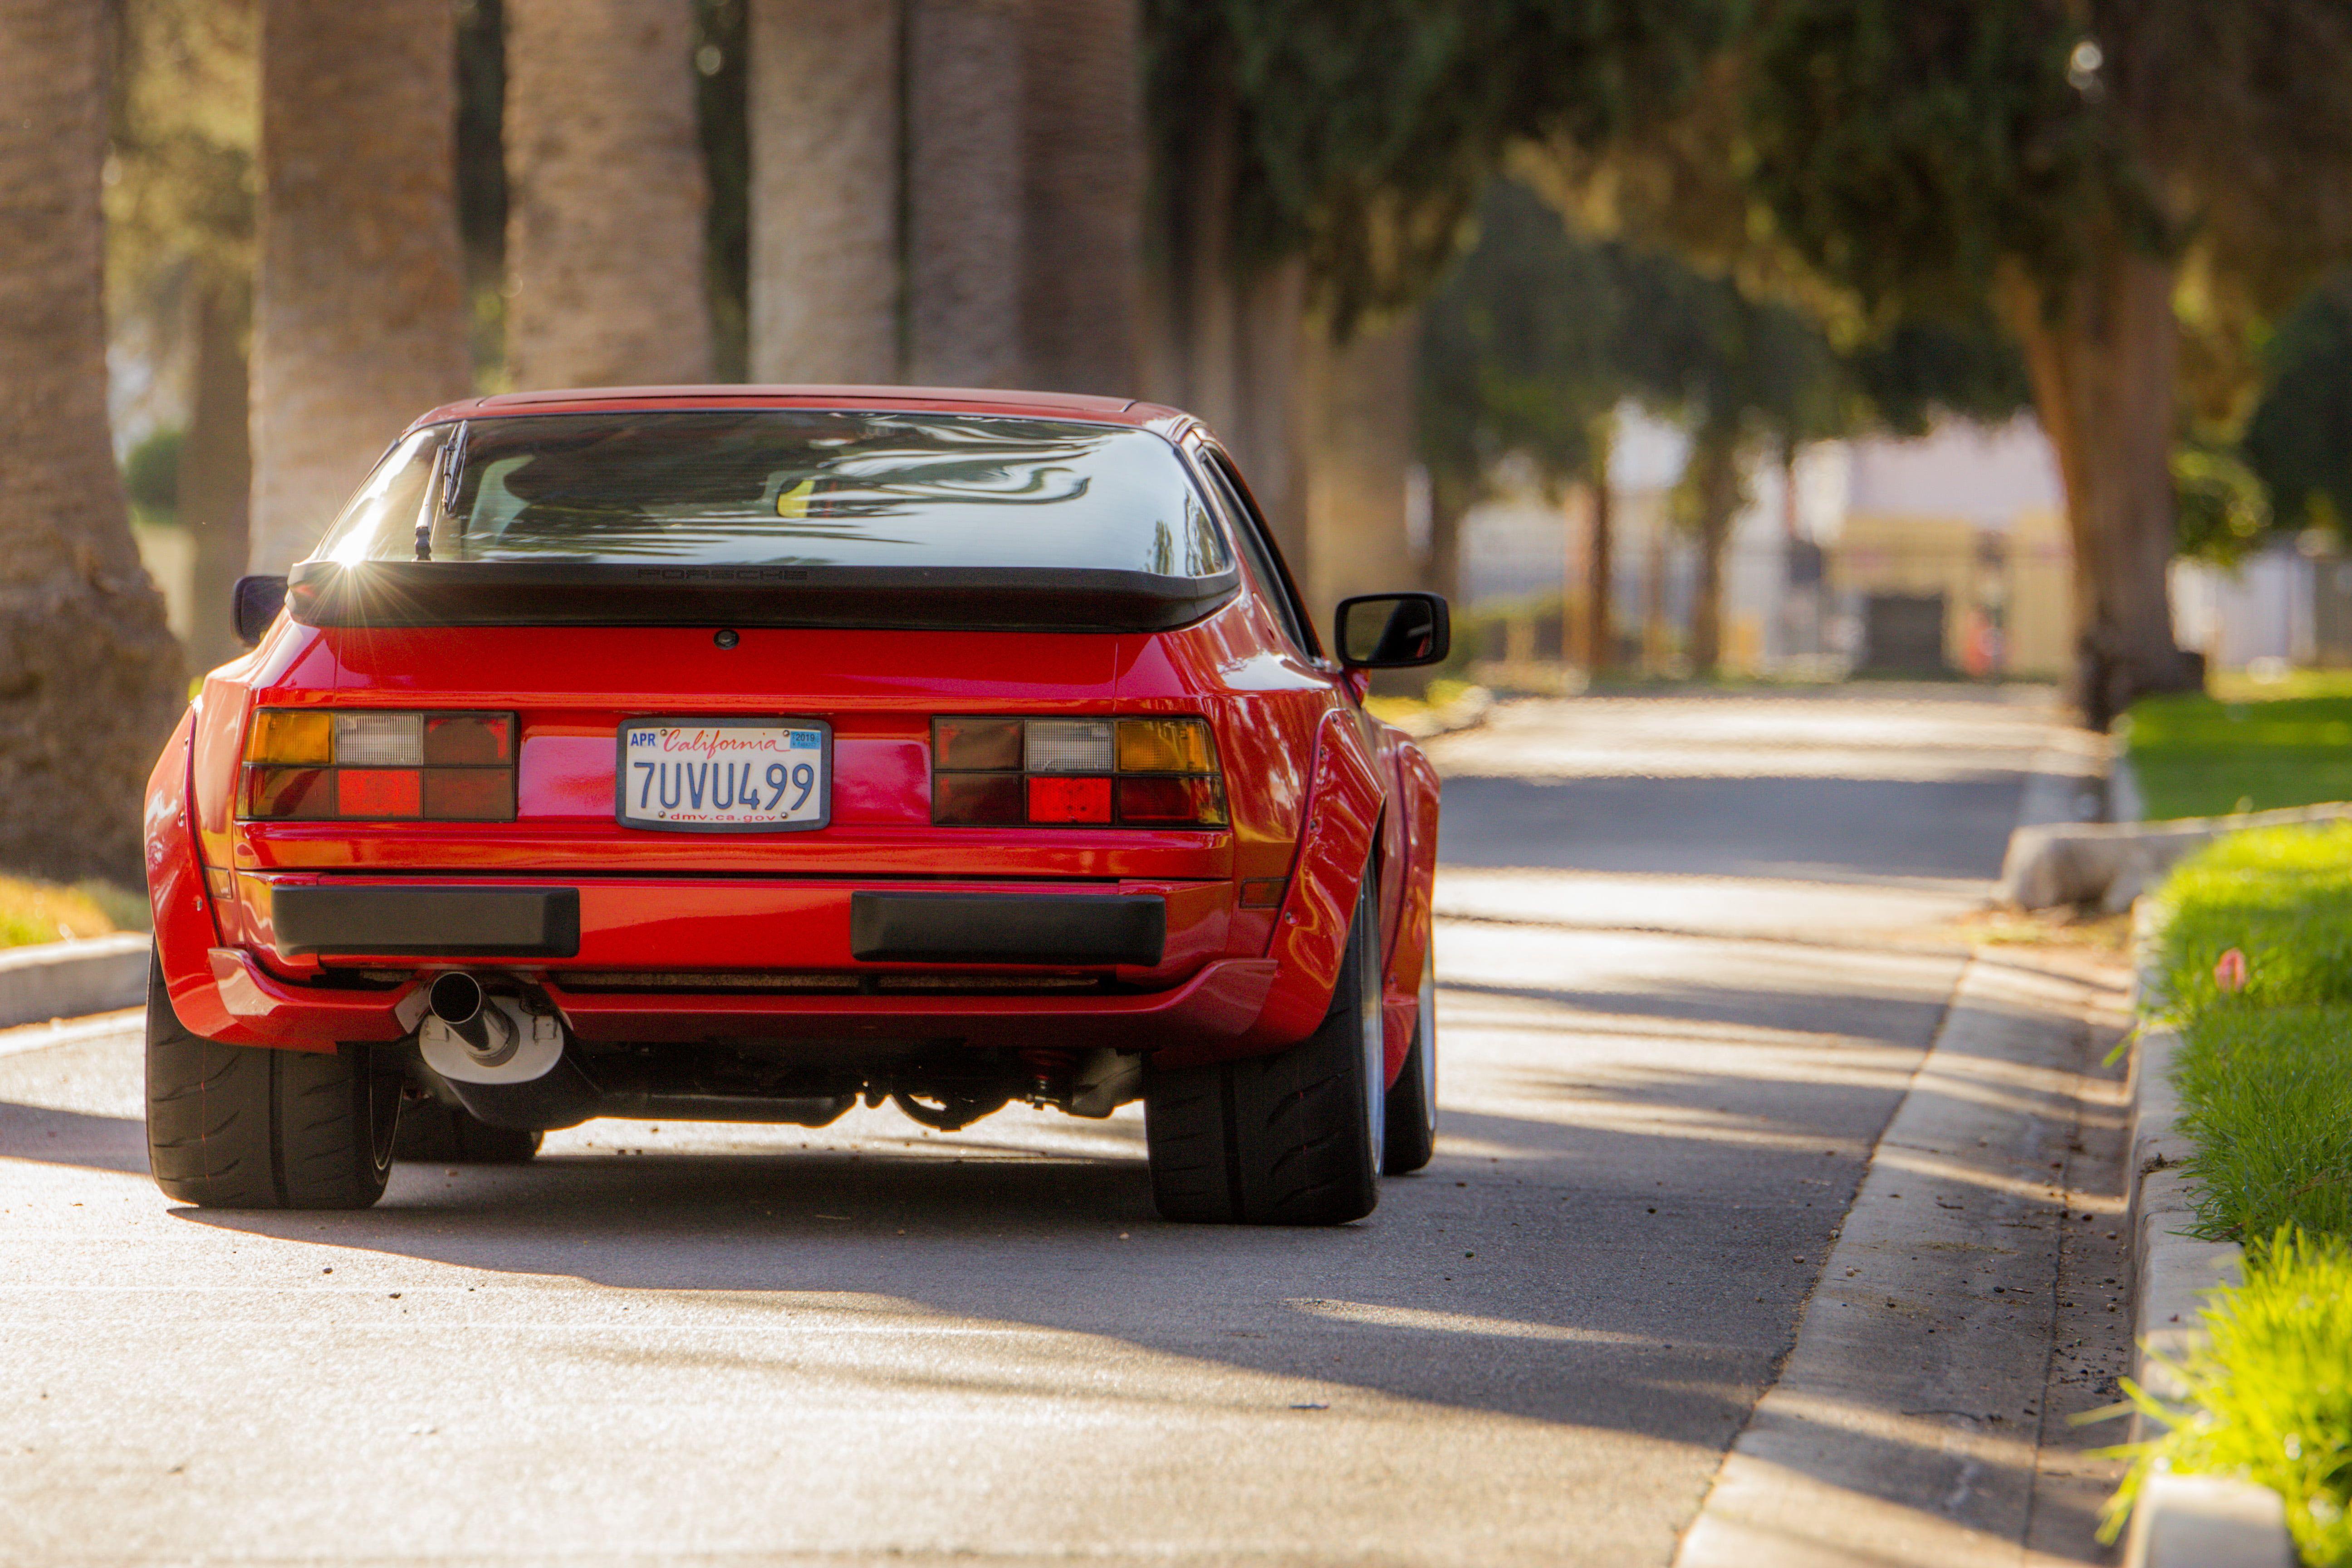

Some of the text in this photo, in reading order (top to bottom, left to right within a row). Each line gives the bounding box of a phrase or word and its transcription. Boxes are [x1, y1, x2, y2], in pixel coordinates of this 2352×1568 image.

[638, 569, 808, 580] PORSCHE
[631, 733, 656, 746] APR
[796, 733, 815, 742] 2019
[663, 729, 791, 760] California
[634, 762, 814, 811] 7UVU499
[670, 813, 776, 822] dmv.ca.gov
